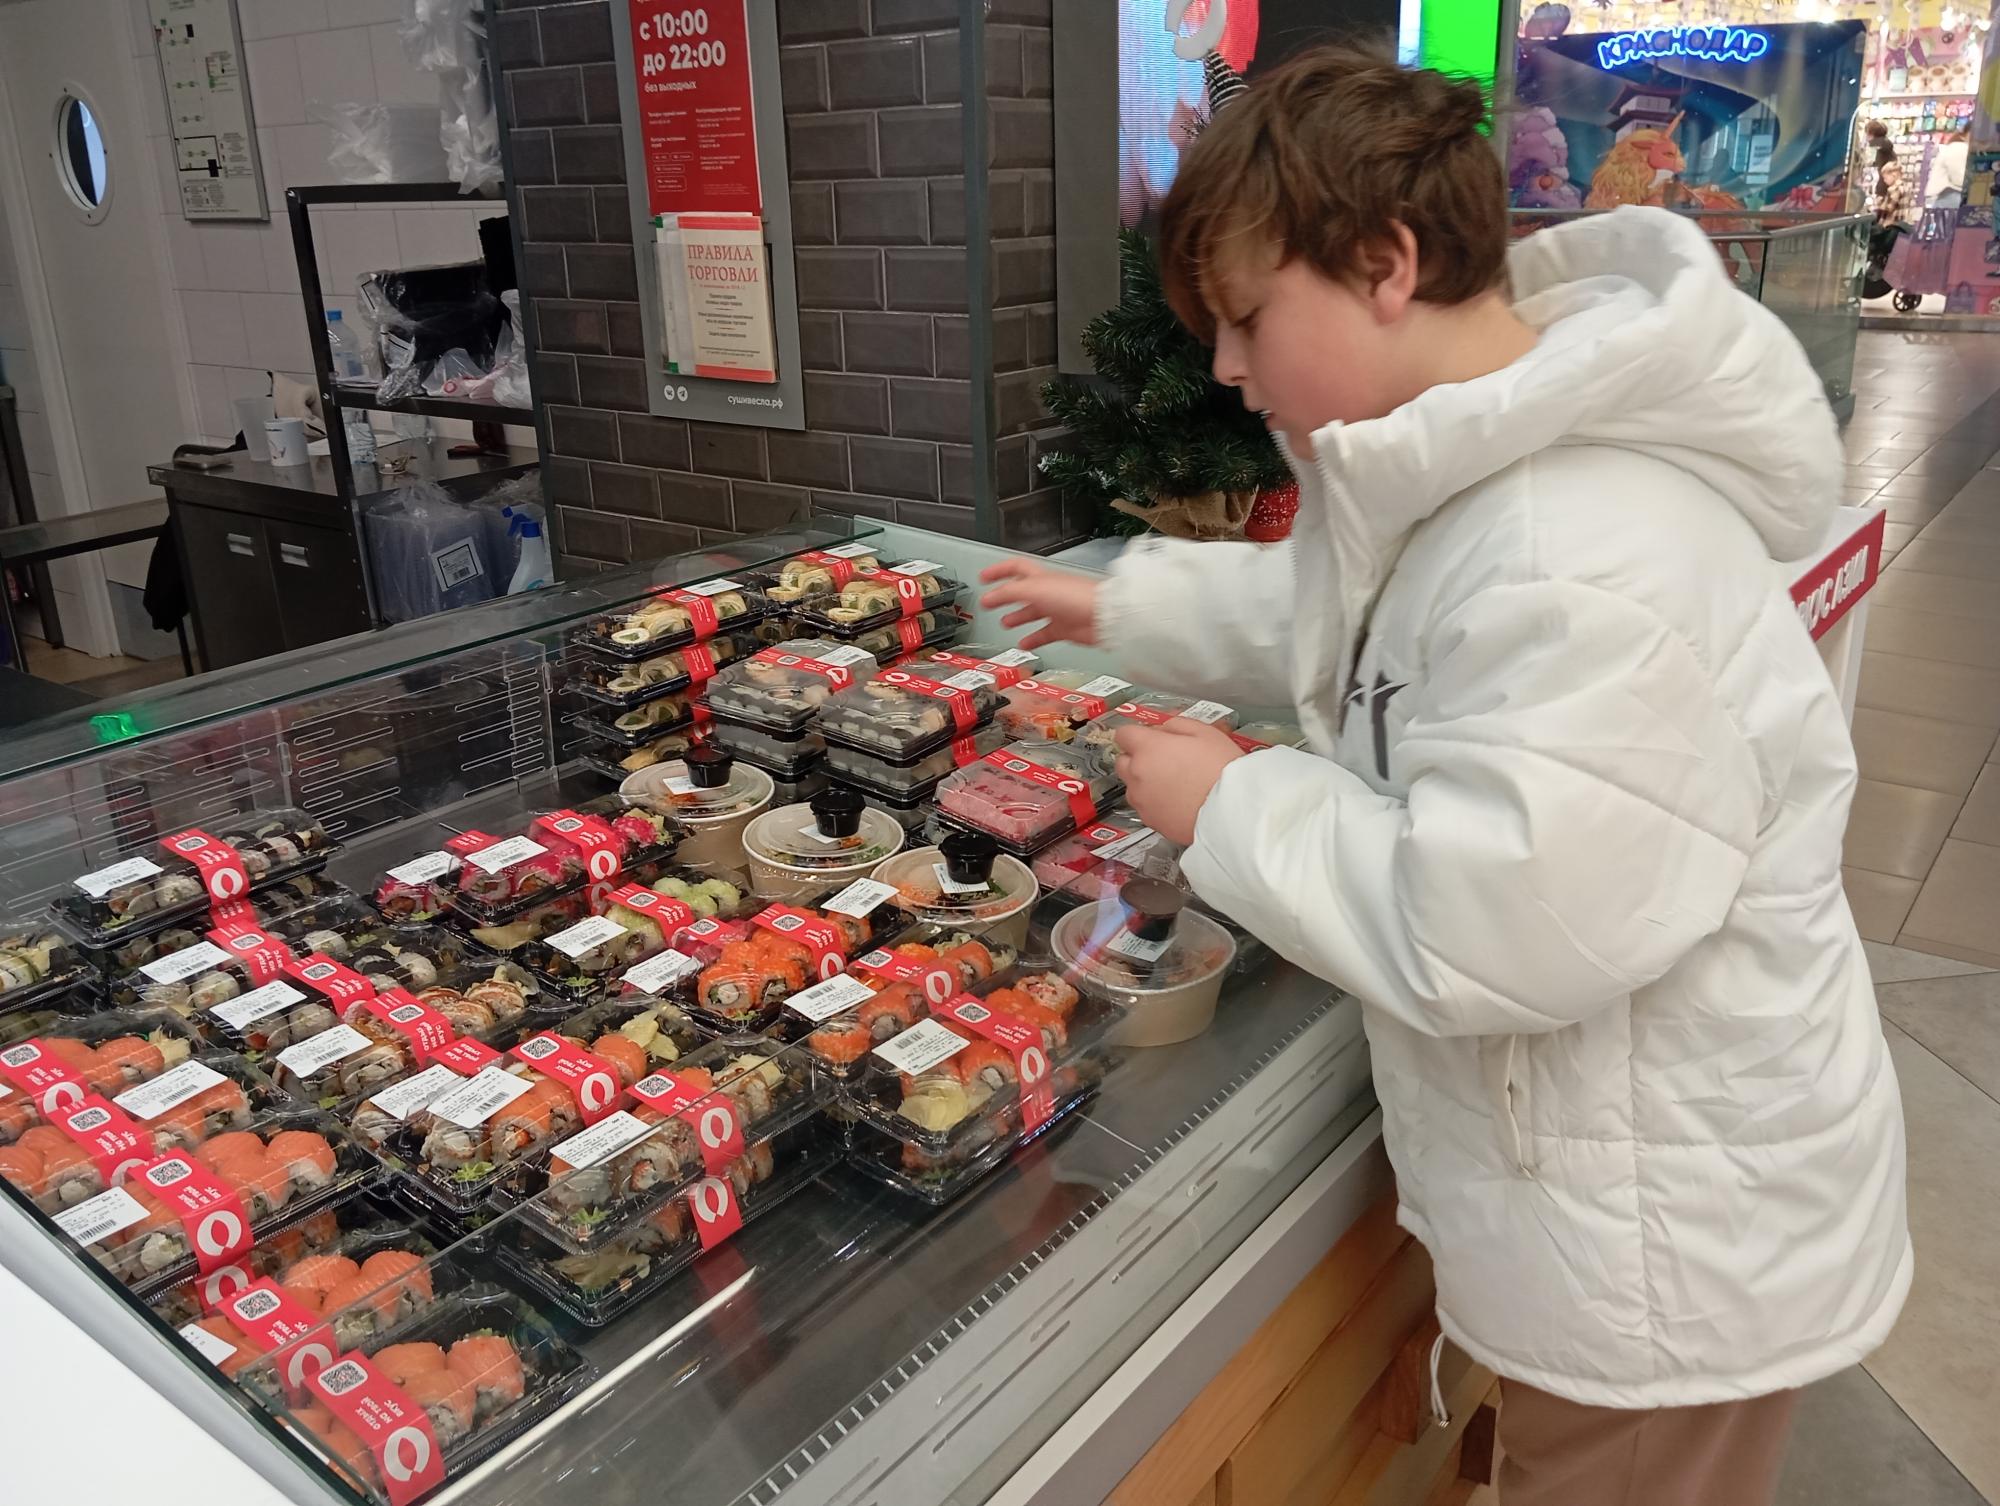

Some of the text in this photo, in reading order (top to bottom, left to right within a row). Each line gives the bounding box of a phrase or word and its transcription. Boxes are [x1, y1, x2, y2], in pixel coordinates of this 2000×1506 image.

[640, 8, 708, 40] с 10:00
[643, 40, 726, 77] до 22:00
[1598, 25, 1767, 69] КРАСНОДАР
[644, 81, 697, 93] без выходных
[687, 244, 754, 261] ПРАВИЛА
[687, 265, 759, 283] ТОРГОВЛИ
